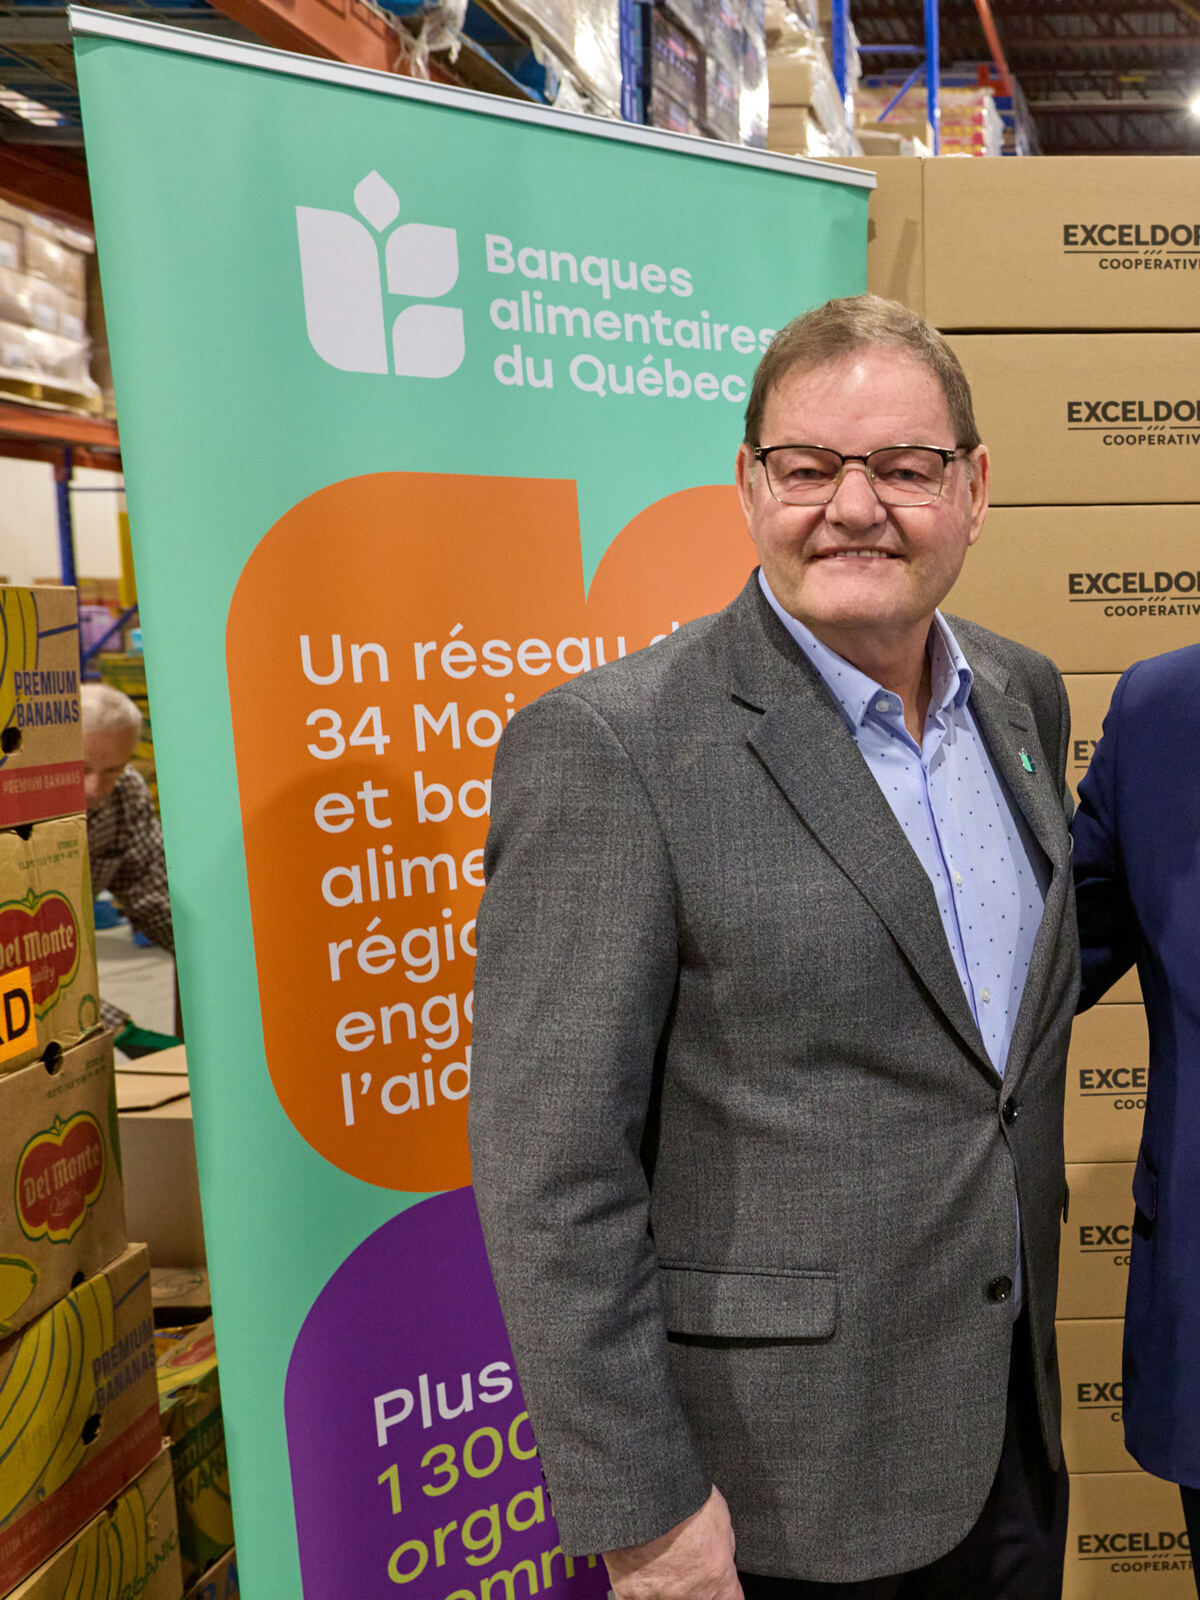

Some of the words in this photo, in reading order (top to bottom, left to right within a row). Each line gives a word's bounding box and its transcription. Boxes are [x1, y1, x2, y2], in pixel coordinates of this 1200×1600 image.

[485, 233, 693, 300] Banques
[489, 290, 779, 354] alimentaires
[494, 344, 554, 389] du
[569, 354, 746, 403] Québec
[14, 670, 77, 697] PREMIUM
[300, 634, 390, 685] Un
[414, 622, 626, 681] réseau
[16, 700, 80, 728] BANANAS
[306, 706, 390, 760] 34
[313, 780, 392, 834] et
[414, 771, 491, 823] ba
[321, 845, 486, 907] alime
[23, 922, 74, 963] Monte
[0, 988, 31, 1046] D
[336, 990, 473, 1052] eng
[23, 1168, 51, 1208] Del
[52, 1143, 100, 1191] Monte
[373, 1361, 513, 1447] Plus
[387, 1485, 556, 1584] orga
